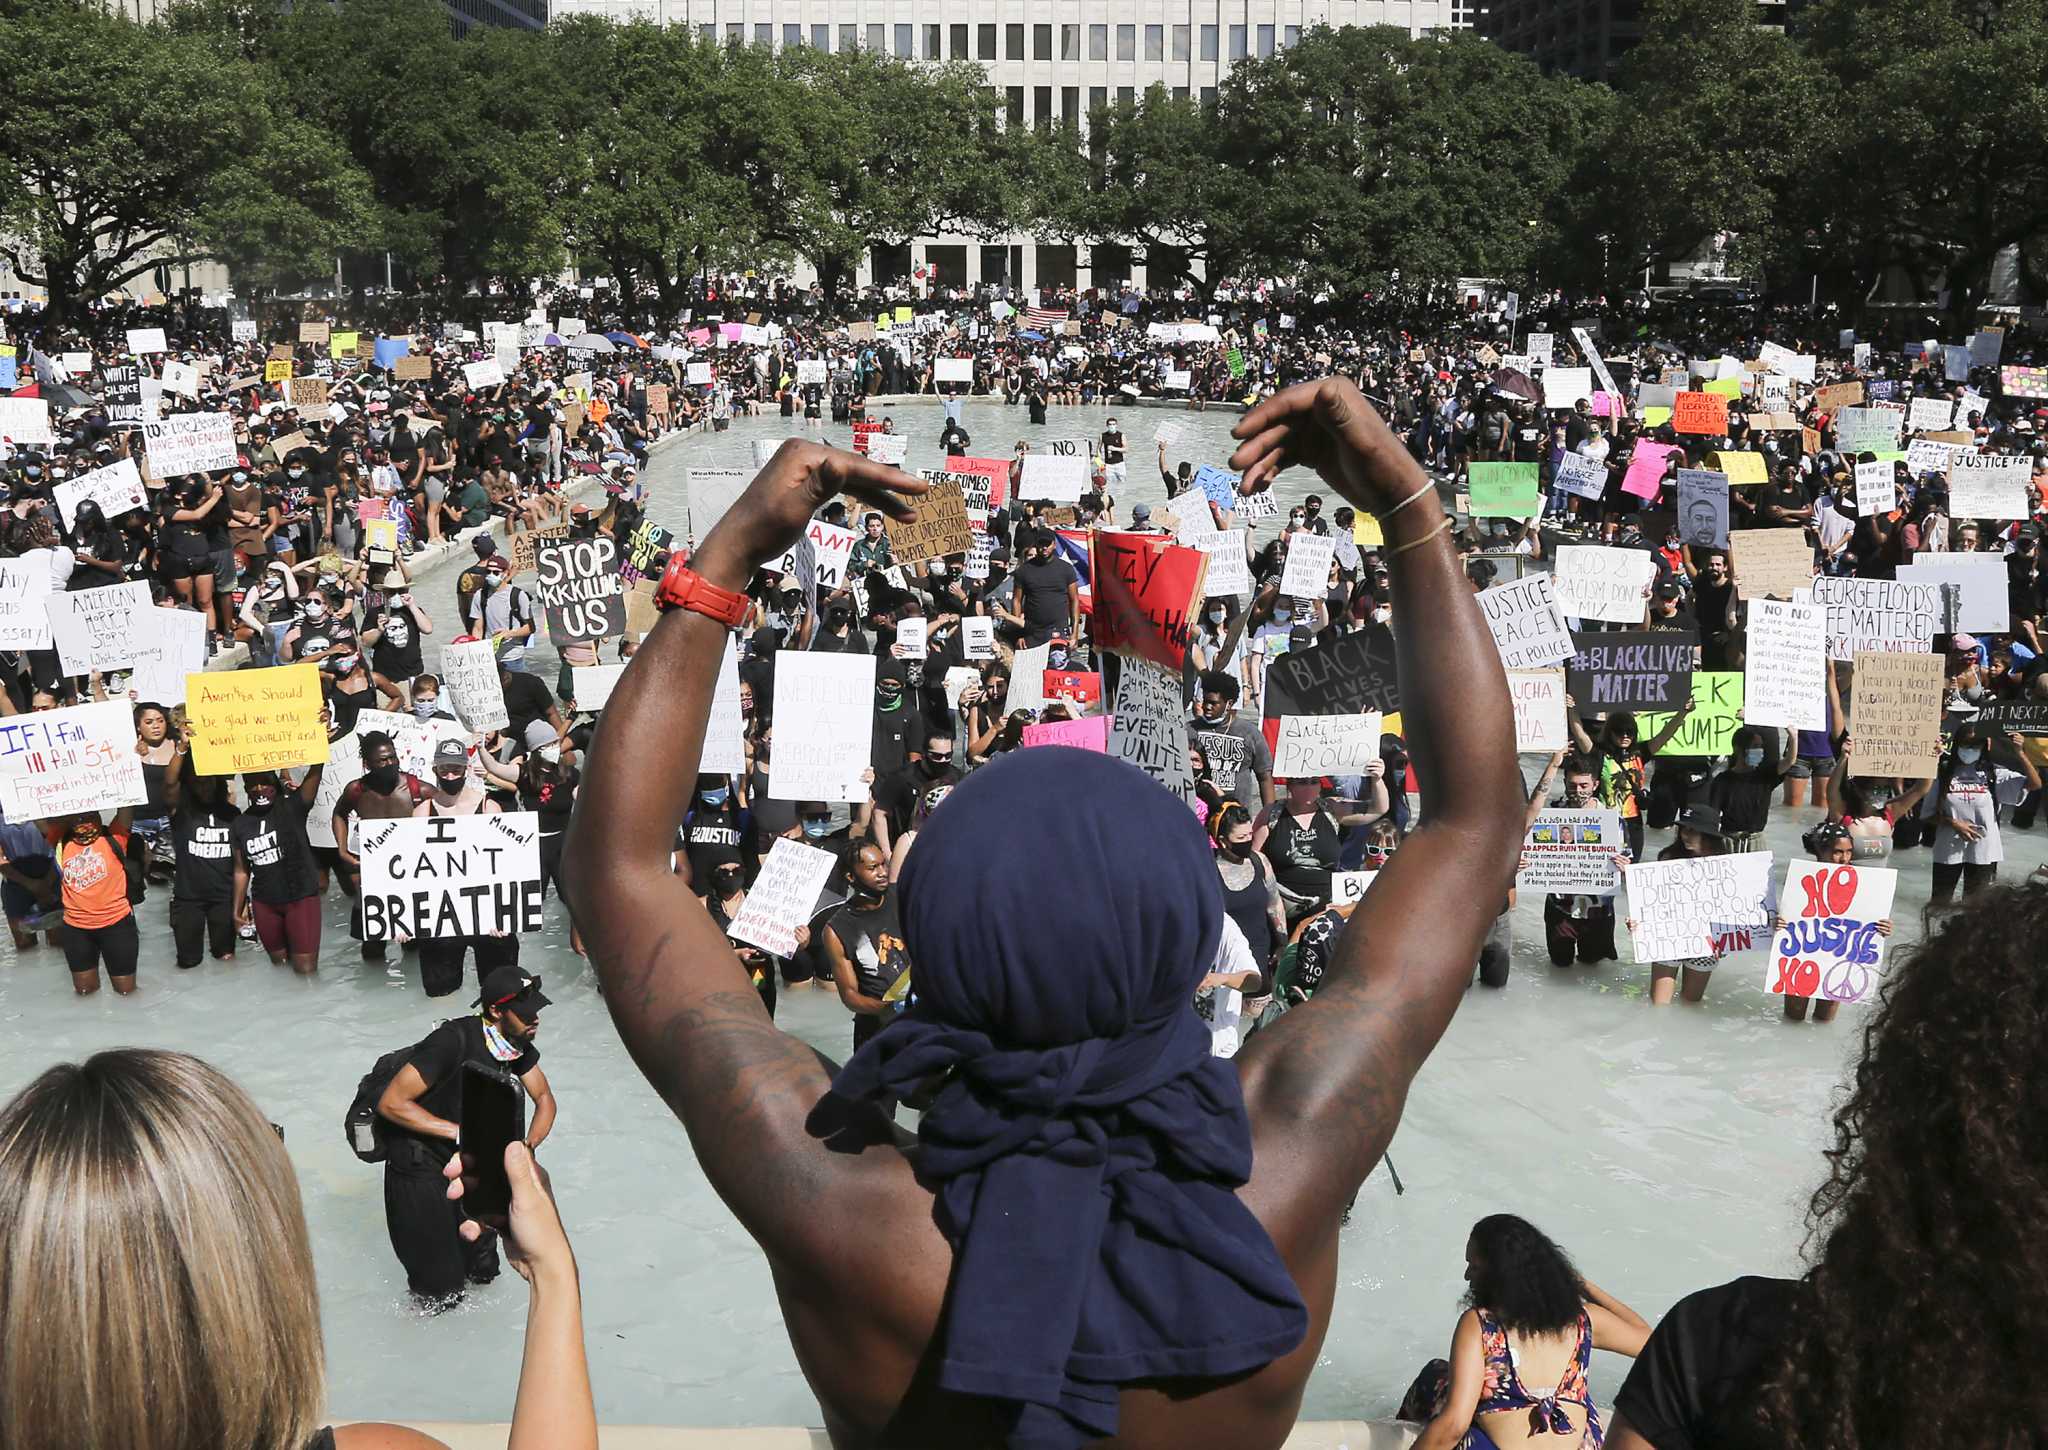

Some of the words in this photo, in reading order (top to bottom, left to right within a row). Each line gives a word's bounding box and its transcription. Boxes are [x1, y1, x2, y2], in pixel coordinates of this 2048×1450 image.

[103, 366, 137, 382] WHITE
[1676, 411, 1713, 424] FUTURE
[1954, 455, 2009, 470] JUSTICE
[2012, 457, 2030, 466] FOR
[955, 473, 990, 493] COMES
[933, 500, 965, 519] WILL
[514, 535, 524, 546] A
[527, 526, 569, 544] SYSTEM
[890, 526, 916, 547] NEVER
[928, 540, 940, 556] I
[539, 537, 616, 586] STOP
[1568, 549, 1606, 575] GOD
[72, 587, 137, 614] AMERICAN
[1483, 579, 1552, 621] USTICE
[1812, 576, 1875, 609] GEORGE
[1878, 581, 1936, 614] FLOYD'S
[562, 599, 610, 638] US
[1577, 601, 1608, 619] MIX
[1764, 604, 1783, 616] NO
[1791, 608, 1812, 621] NO
[1494, 608, 1561, 647] EACE!
[1826, 606, 1847, 635] FE
[1850, 608, 1934, 642] MATTERED
[1287, 635, 1390, 692] BLACK
[1525, 639, 1569, 663] POLICE
[1570, 645, 1692, 672] #BLACKLIVES
[1322, 671, 1384, 701] LIVES
[1591, 673, 1670, 703] MATTER
[1117, 693, 1142, 713] Poor
[1980, 706, 1996, 721] AM
[1999, 705, 2005, 720] I
[2009, 705, 2048, 720] NEXT?
[201, 714, 217, 728] be
[225, 712, 249, 730] glad
[255, 715, 267, 725] we
[276, 711, 300, 730] only
[1646, 714, 1735, 750] TRUMP
[297, 729, 316, 742] and
[232, 753, 256, 768] NOT
[1122, 737, 1184, 772] UNITE
[1282, 742, 1373, 775] PROUD
[208, 813, 215, 827] I
[259, 820, 266, 835] I
[196, 826, 230, 843] CAN'T
[246, 830, 278, 855] CAN'T
[363, 821, 398, 854] Mama
[425, 817, 457, 843] I
[488, 815, 534, 848] Mama!
[388, 846, 503, 879] CAN'T
[1546, 861, 1562, 870] apple
[1580, 871, 1600, 879] they're
[1633, 866, 1656, 888] IT
[1662, 863, 1686, 885] IS
[1690, 858, 1738, 882] OUR
[1531, 879, 1546, 888] being
[1595, 879, 1615, 887] #BLM
[1642, 880, 1701, 907] DUTY
[1705, 876, 1737, 900] TO
[1800, 865, 1858, 918] NO
[364, 879, 543, 942] BREATHE
[1640, 901, 1687, 923] FIGHT
[1693, 899, 1724, 917] FOR
[1635, 937, 1678, 962] DUTY
[1681, 935, 1702, 956] TO
[1704, 930, 1752, 957] WIN
[1772, 956, 1821, 997] NO
